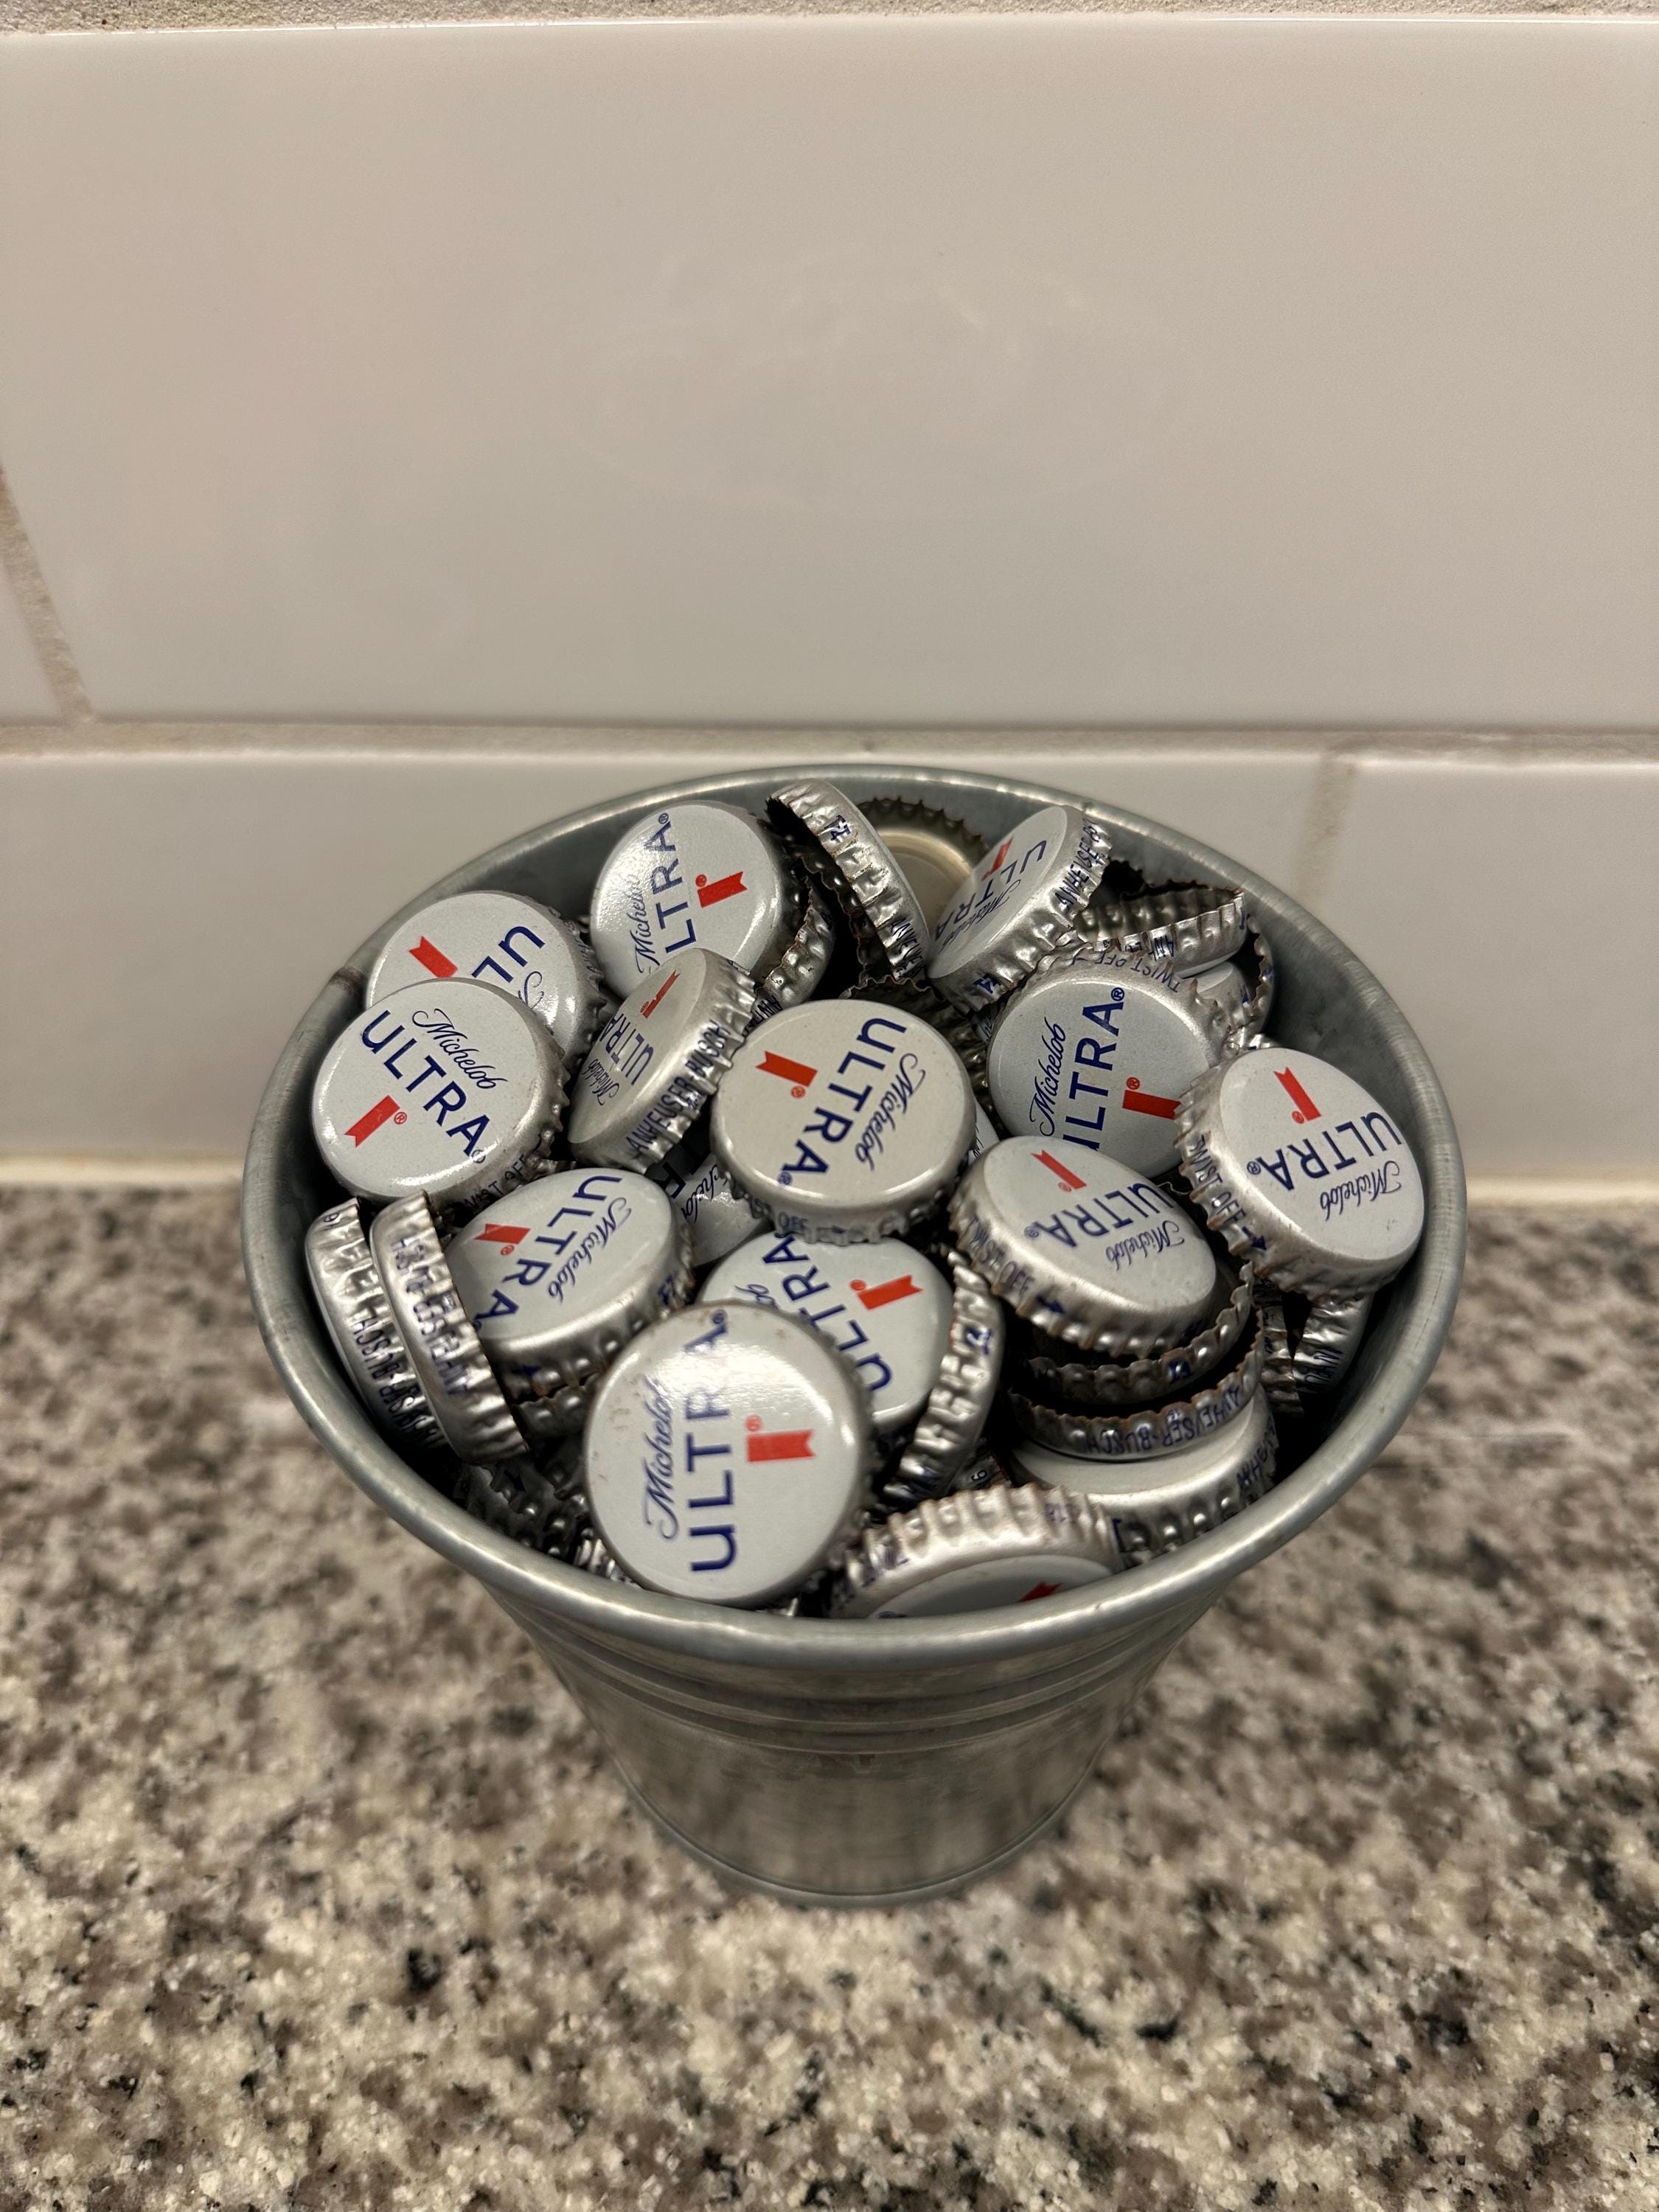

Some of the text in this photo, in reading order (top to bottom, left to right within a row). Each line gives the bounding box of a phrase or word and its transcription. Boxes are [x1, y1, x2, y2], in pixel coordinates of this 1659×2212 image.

[411, 1007, 509, 1090] Michelob
[1029, 1017, 1067, 1136] Michelob
[855, 1053, 926, 1172] Michelob
[1320, 1160, 1402, 1221] Michelob
[548, 1196, 632, 1303] Michelob
[1106, 1220, 1185, 1271] Michelob
